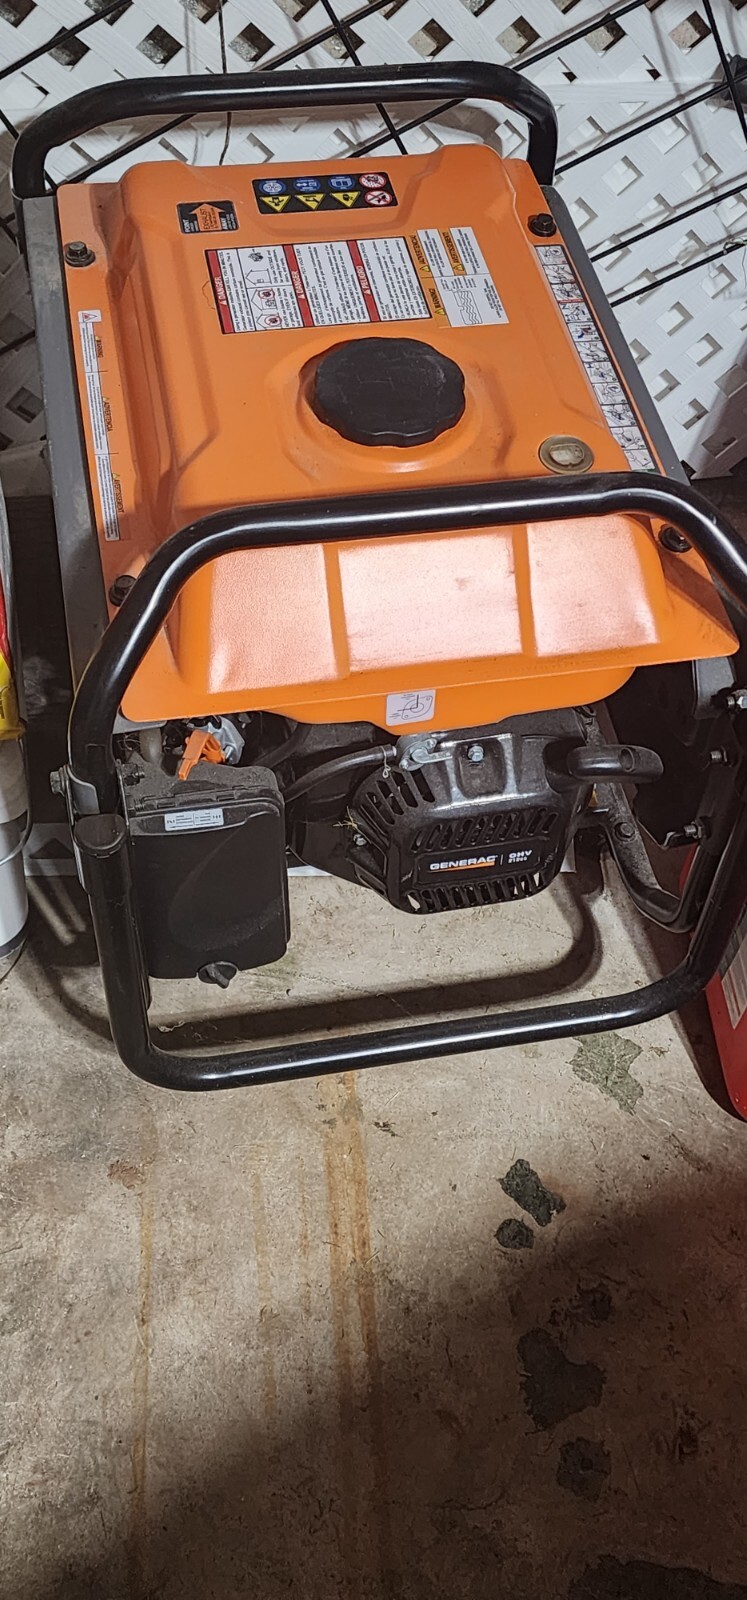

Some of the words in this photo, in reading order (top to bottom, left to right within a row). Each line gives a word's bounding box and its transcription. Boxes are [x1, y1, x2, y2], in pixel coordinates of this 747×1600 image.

[214, 275, 225, 299] DANGER
[291, 270, 303, 293] DANGER
[356, 265, 369, 288] PELIGRO
[429, 856, 495, 870] GENERAC
[508, 850, 533, 860] OHV
